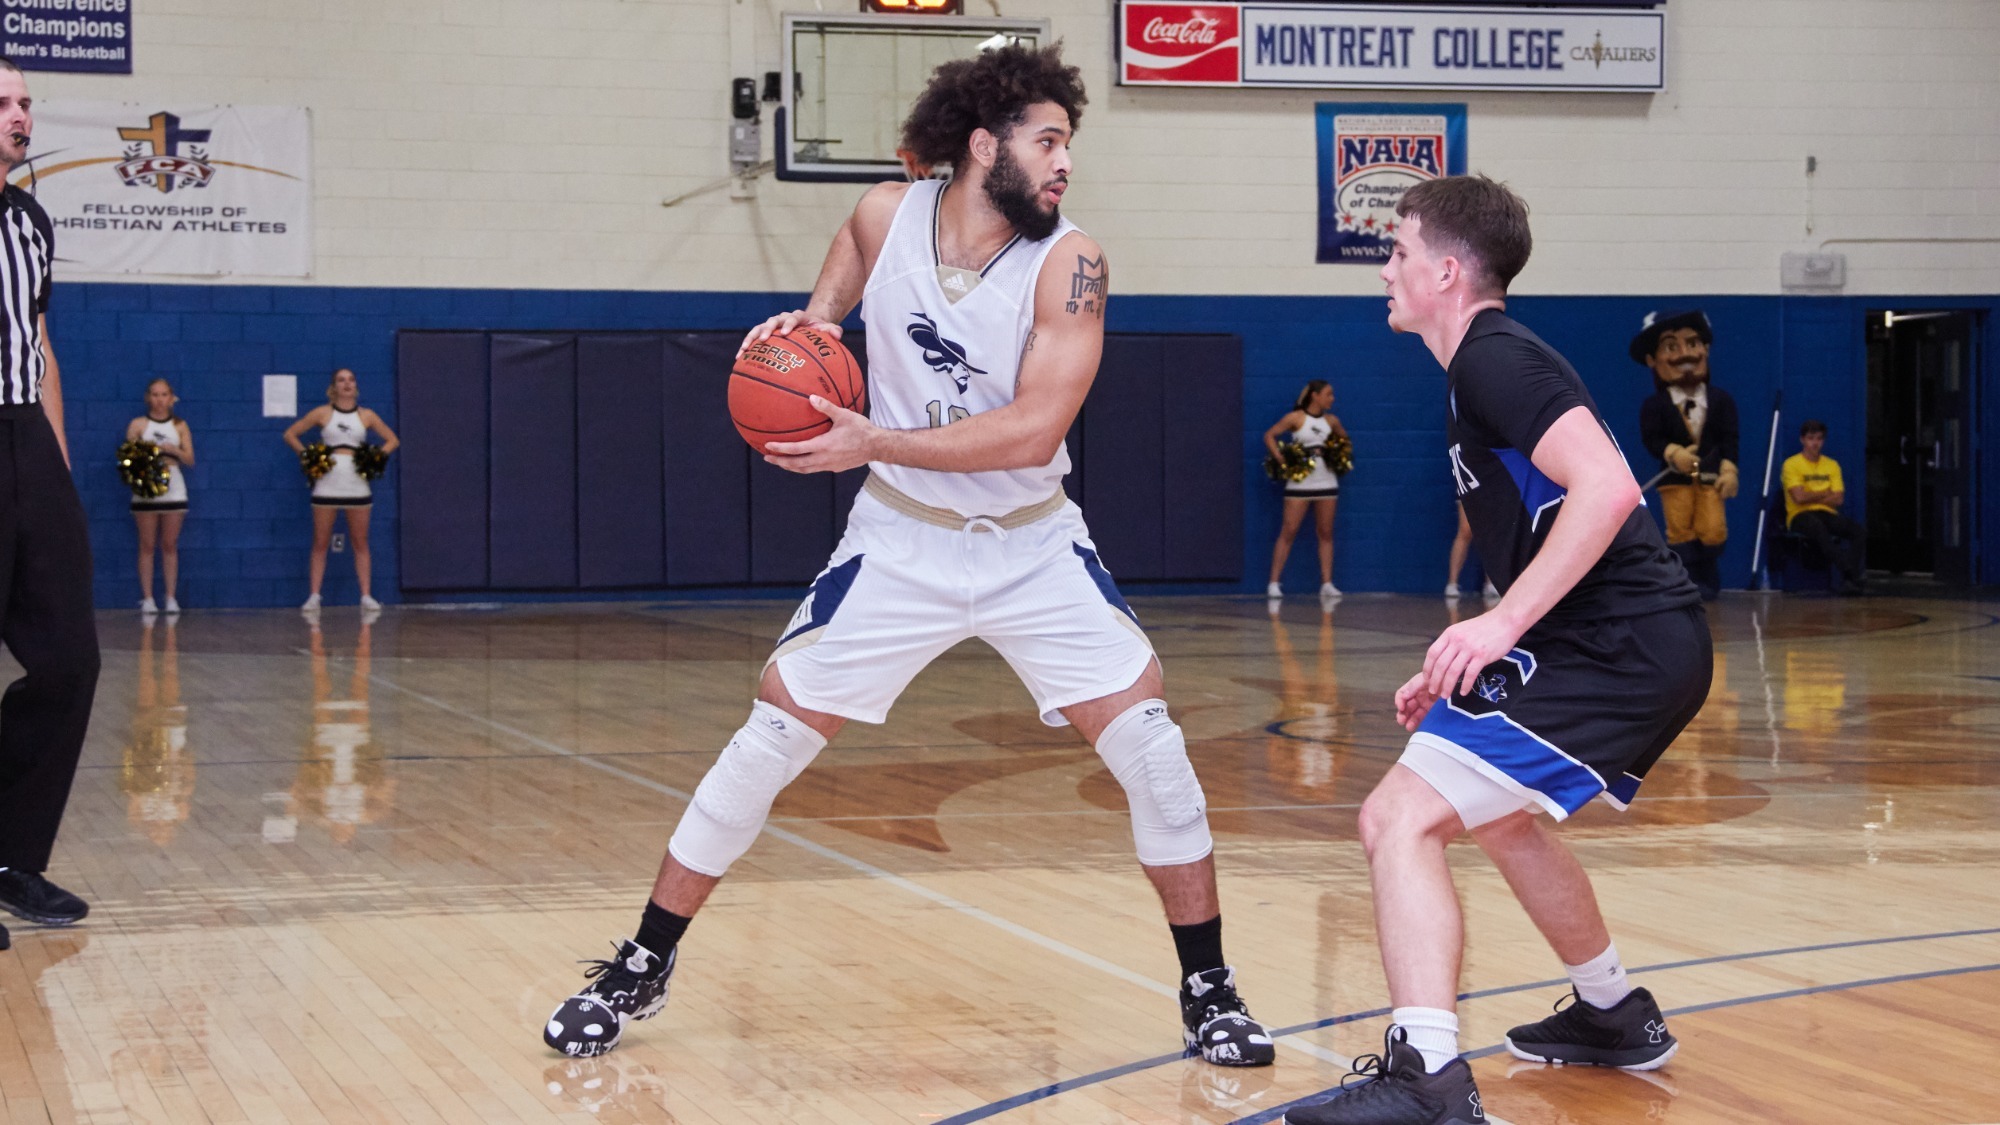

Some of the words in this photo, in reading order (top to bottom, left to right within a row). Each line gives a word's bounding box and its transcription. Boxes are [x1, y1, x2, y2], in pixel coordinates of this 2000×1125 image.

[4, 12, 126, 41] Champions
[5, 42, 48, 57] Men's
[51, 44, 126, 60] Basketball
[1256, 24, 1415, 68] MONTREAT
[1433, 27, 1564, 70] COLLEGE
[1341, 138, 1439, 176] NAIA
[127, 159, 204, 178] FCA
[1355, 184, 1411, 196] Champio
[83, 203, 213, 216] FELLOWSHIP
[222, 207, 247, 217] OF
[1350, 197, 1364, 208] of
[53, 217, 162, 231] HRISTIAN
[173, 220, 286, 234] ATHLETES
[747, 342, 806, 369] EGACY
